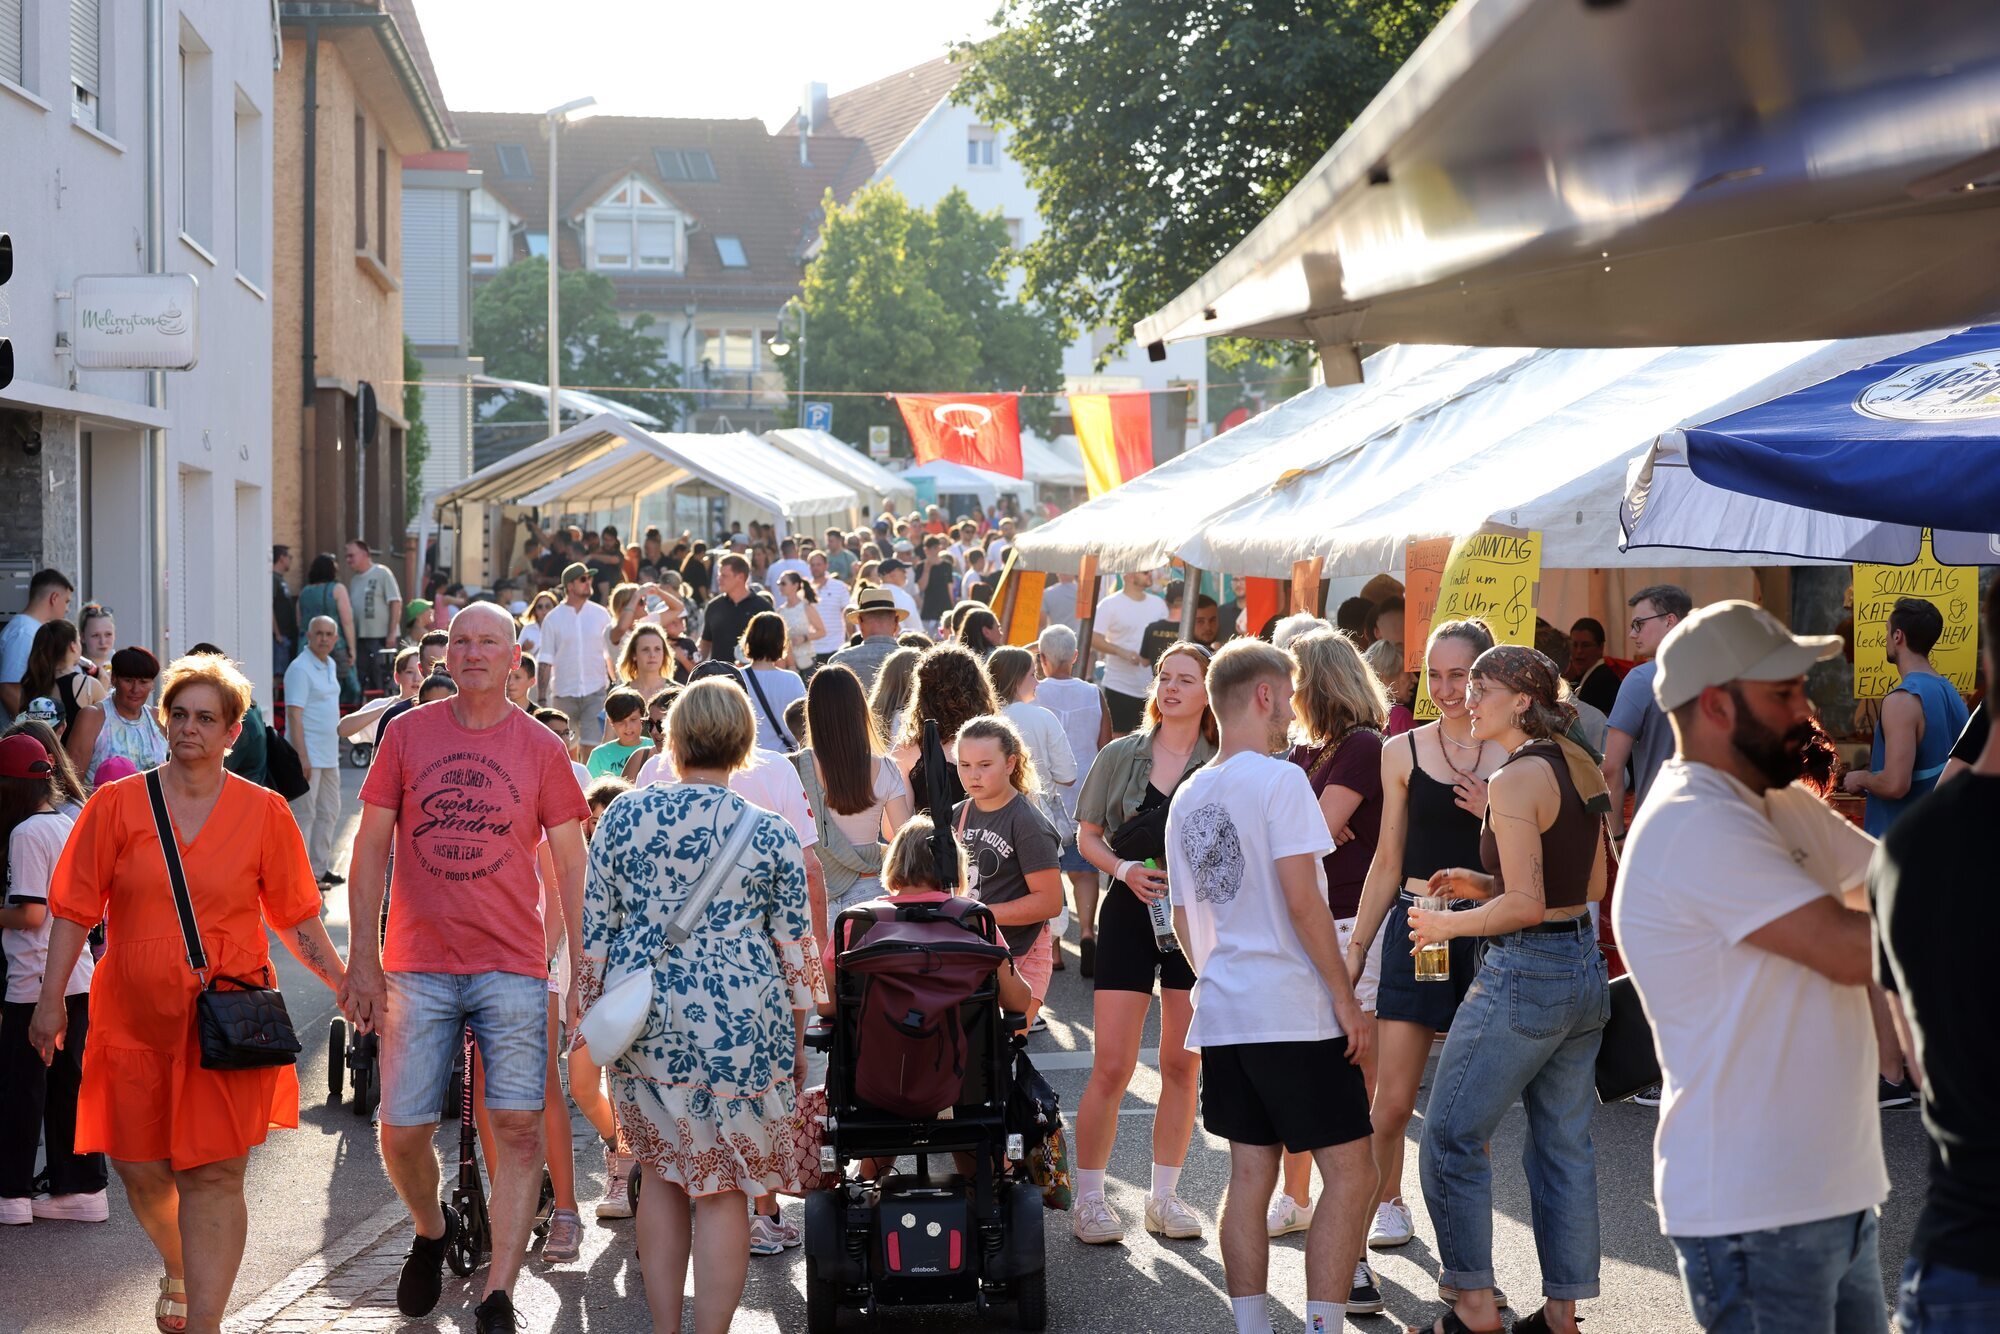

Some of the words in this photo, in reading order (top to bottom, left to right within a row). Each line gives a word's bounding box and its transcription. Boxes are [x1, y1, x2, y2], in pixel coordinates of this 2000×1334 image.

[1466, 535, 1533, 559] SONNTAG
[1476, 575, 1497, 585] um
[1872, 567, 1959, 593] SONNTAG
[1445, 592, 1459, 612] 13
[1464, 592, 1501, 612] Uhr
[1858, 601, 1895, 621] KAF
[1856, 630, 1887, 648] lecke
[1859, 660, 1884, 674] und
[440, 768, 485, 788] ESTABLISHED
[442, 751, 481, 765] GARMENTS
[487, 759, 512, 783] QUALITY
[508, 783, 520, 804] WEAR
[980, 829, 1014, 859] MOUSE
[419, 856, 427, 868] TO
[424, 863, 443, 878] LAST
[445, 870, 470, 881] GOODS
[472, 868, 487, 880] AND
